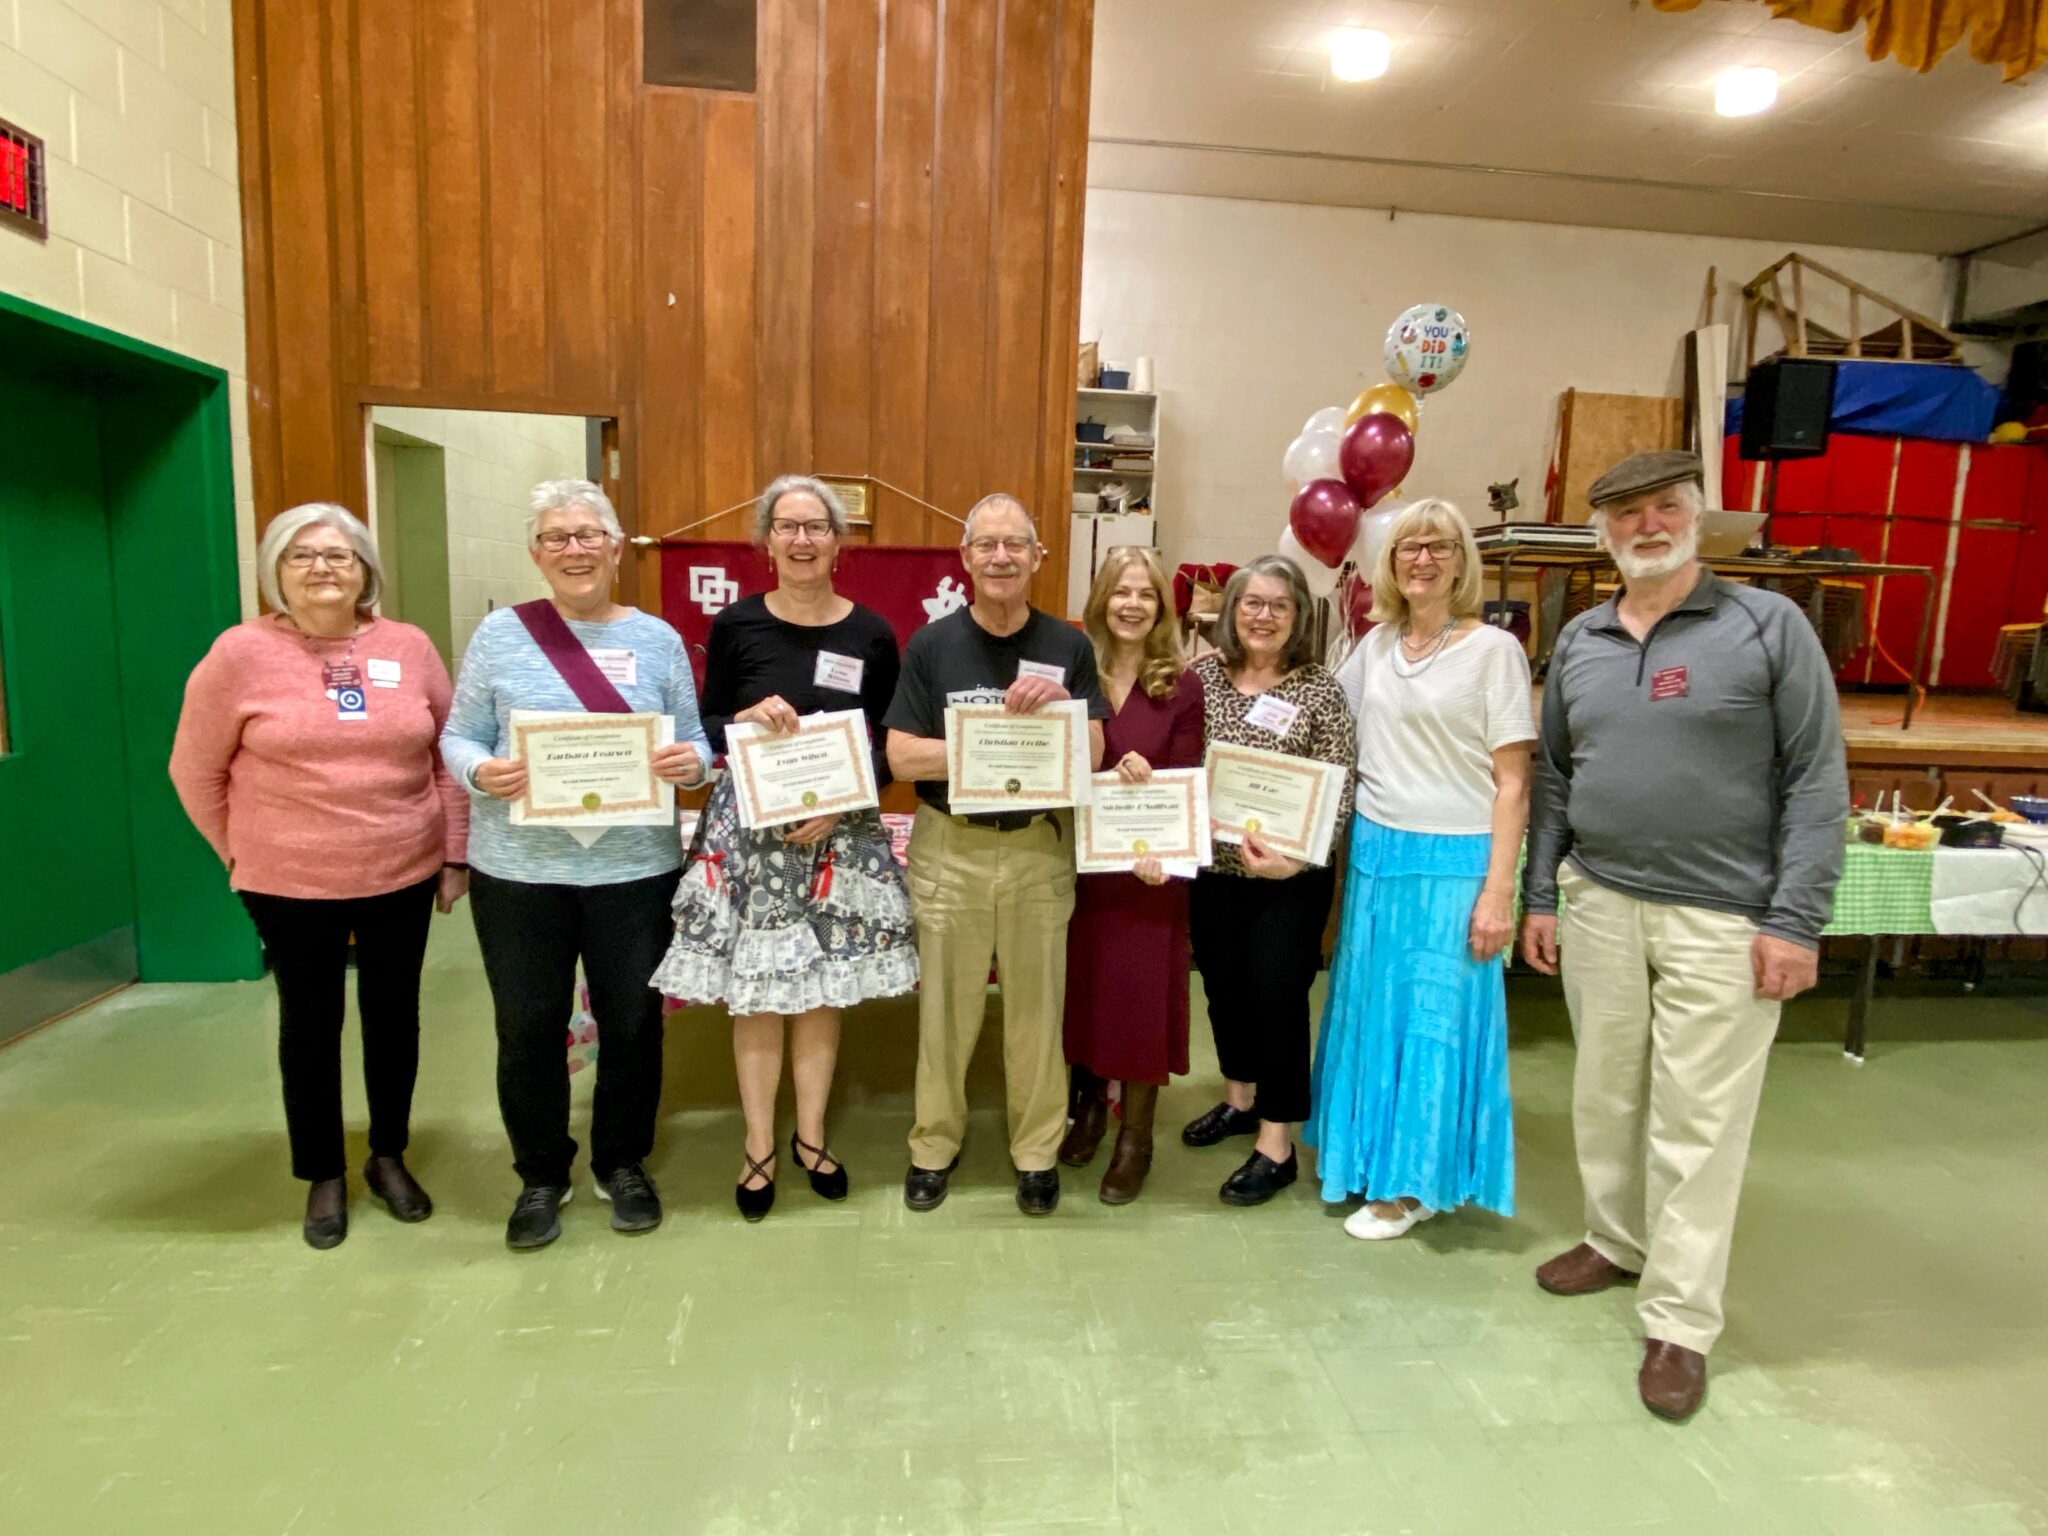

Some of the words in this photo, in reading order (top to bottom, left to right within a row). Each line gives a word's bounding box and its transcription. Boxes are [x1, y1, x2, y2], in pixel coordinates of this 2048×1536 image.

[1424, 325, 1448, 338] YOU
[1420, 355, 1443, 369] IT!
[546, 752, 589, 761] Barbara
